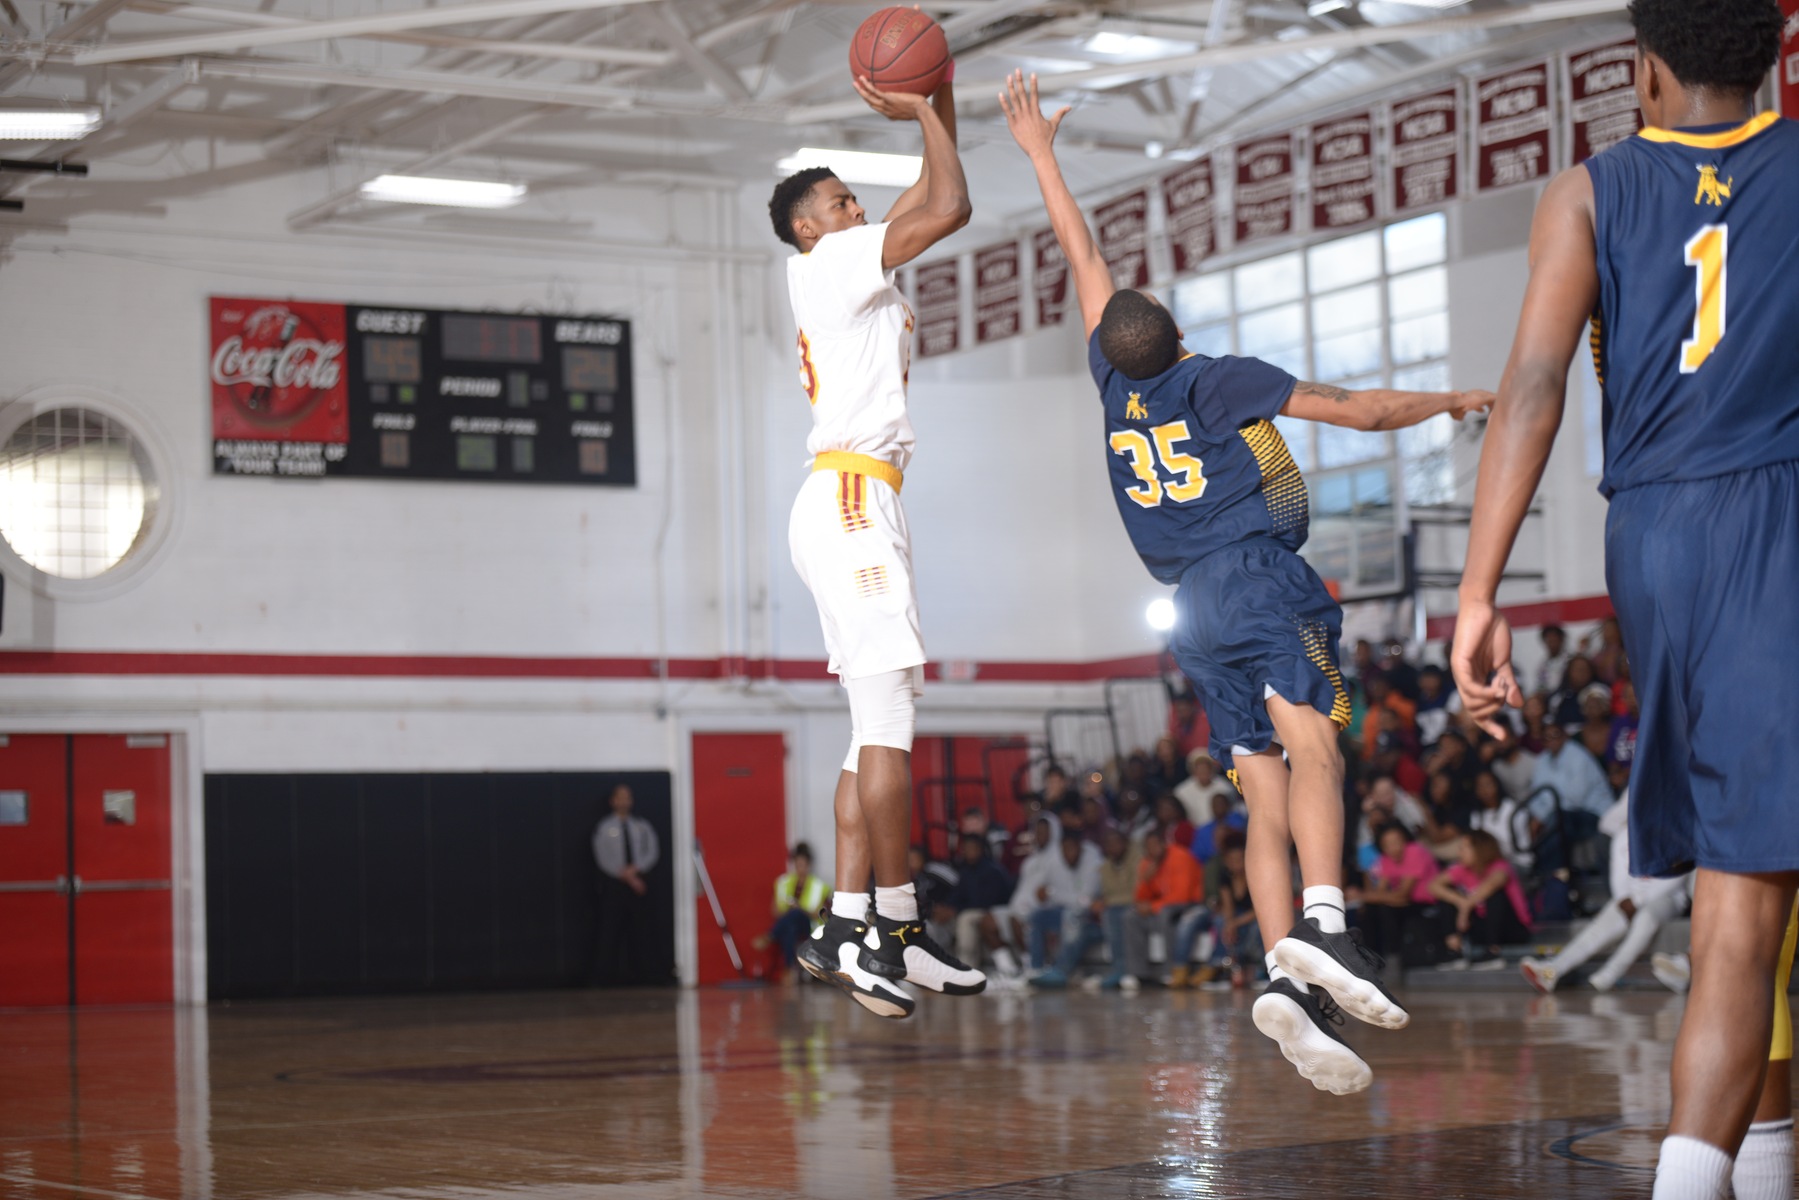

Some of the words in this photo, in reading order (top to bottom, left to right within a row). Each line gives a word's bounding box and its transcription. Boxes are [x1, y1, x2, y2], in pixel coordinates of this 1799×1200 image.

[1680, 223, 1728, 374] 1
[356, 309, 426, 334] GUEST
[555, 320, 622, 345] BEARS
[440, 376, 502, 398] PERIOD
[1109, 420, 1208, 508] 35
